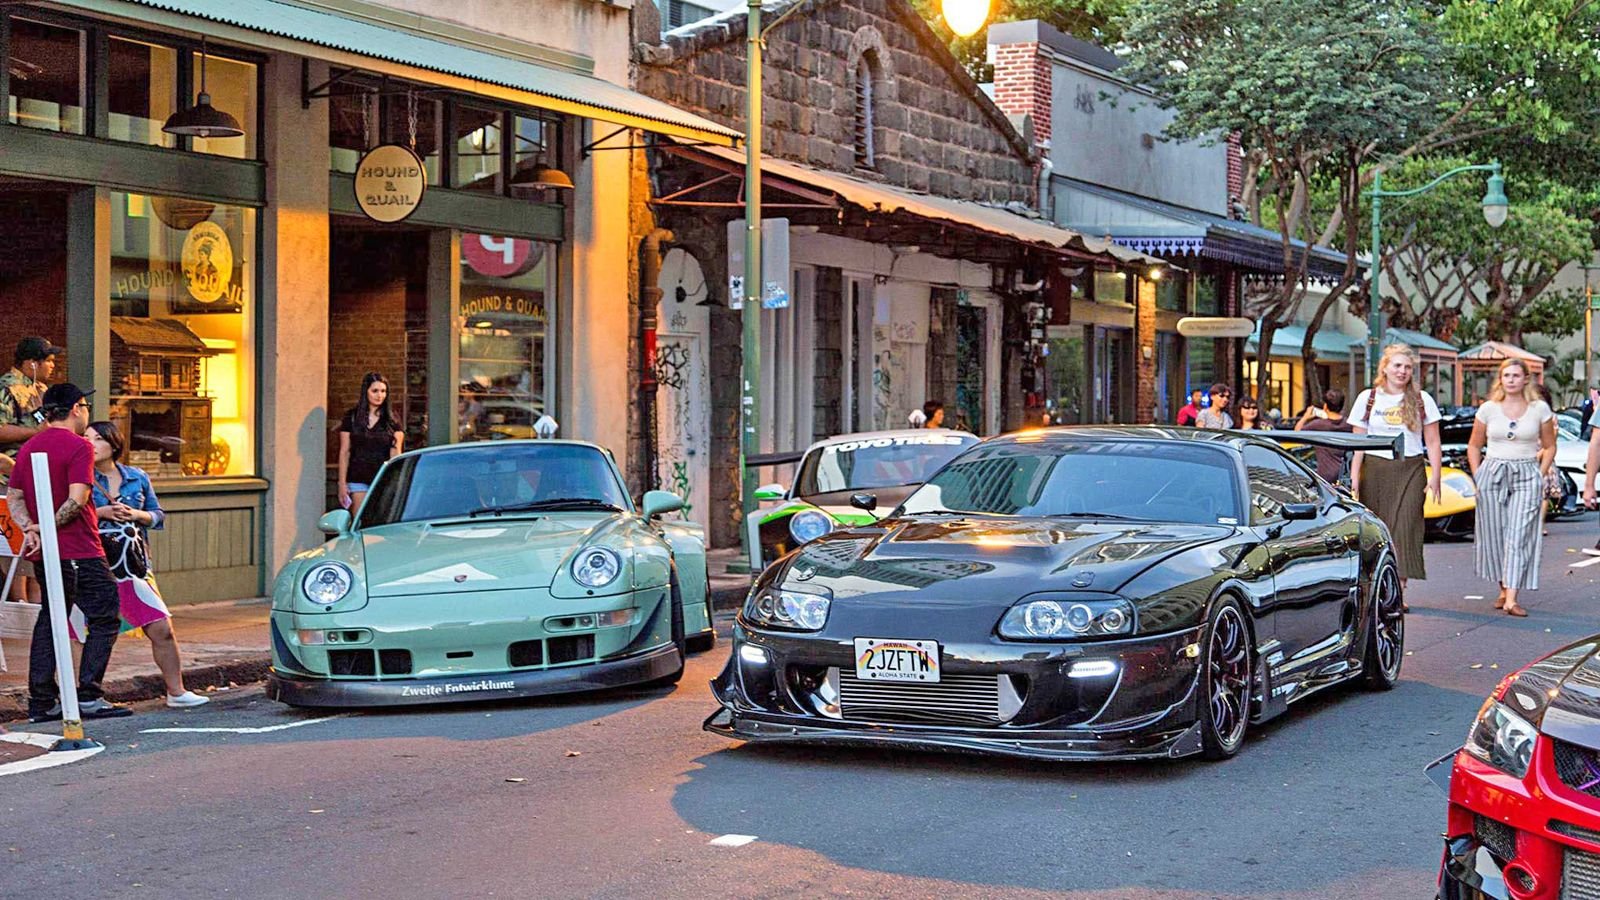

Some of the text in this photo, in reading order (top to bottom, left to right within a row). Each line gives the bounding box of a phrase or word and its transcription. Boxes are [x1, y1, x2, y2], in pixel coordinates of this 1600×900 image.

[361, 166, 420, 178] HOUND
[385, 181, 397, 192] &
[366, 194, 415, 206] QUAIL
[116, 270, 174, 297] HOUND
[461, 295, 501, 317] HOUND
[505, 296, 513, 311] &
[865, 649, 929, 672] 2JZFTW
[401, 685, 442, 696] Zweite
